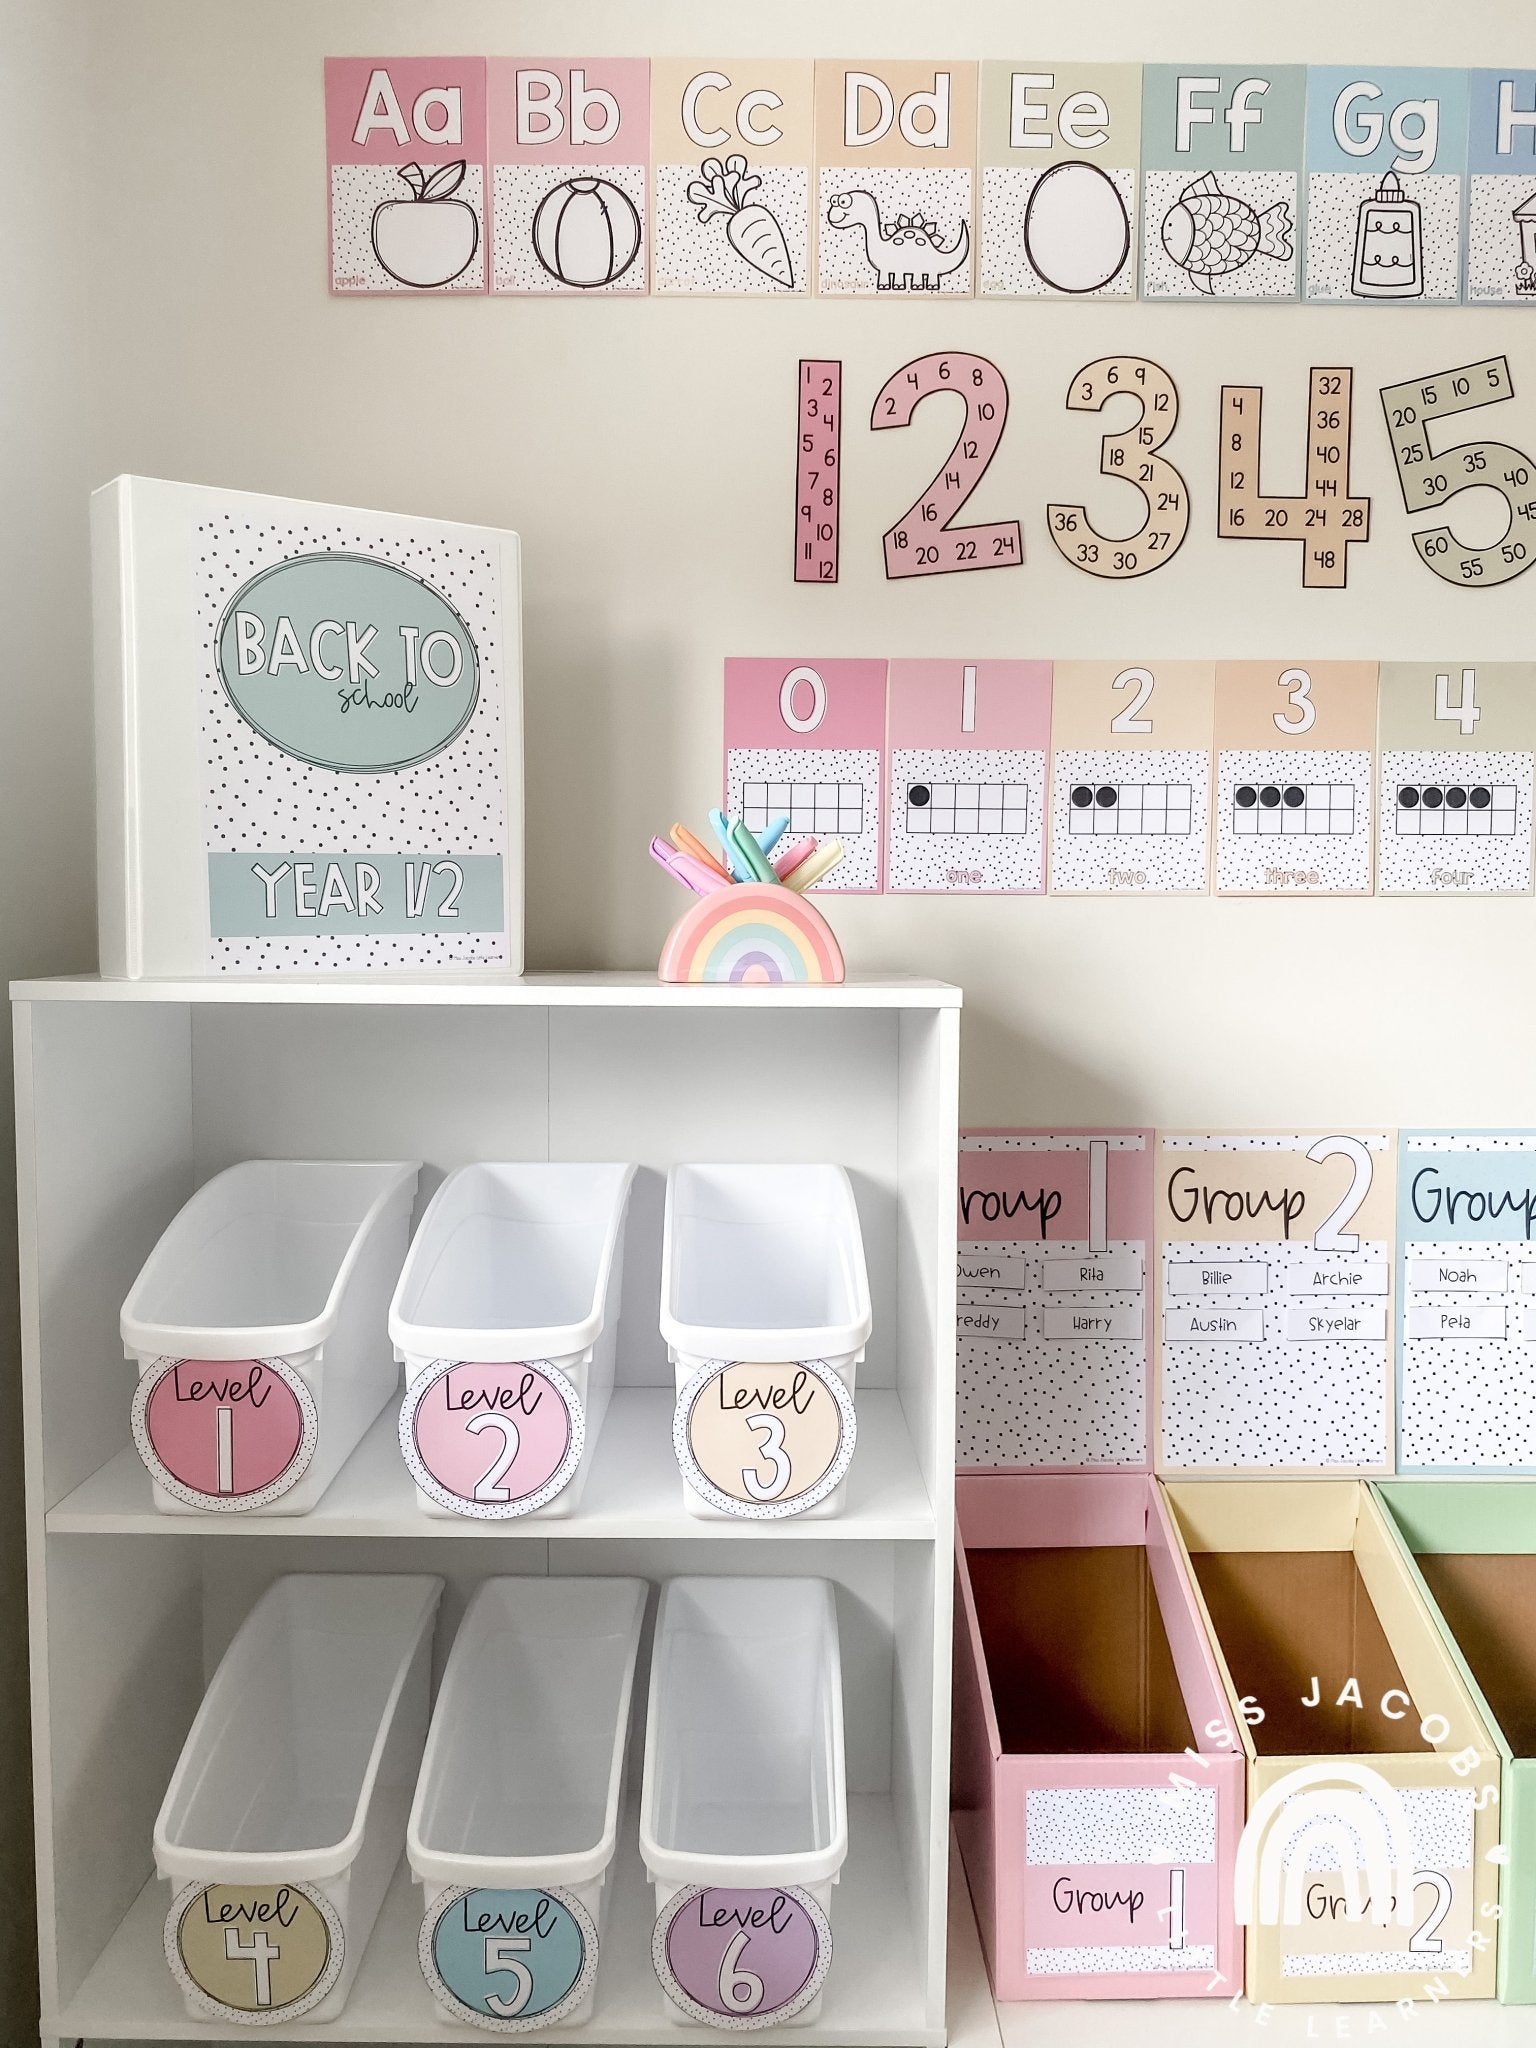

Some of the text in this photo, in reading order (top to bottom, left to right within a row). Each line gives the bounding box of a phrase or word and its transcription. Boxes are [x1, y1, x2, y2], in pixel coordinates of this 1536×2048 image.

[351, 69, 463, 147] Aa
[516, 69, 621, 146] Bb
[681, 71, 784, 147] Cc
[844, 71, 951, 148] Dd
[1009, 72, 1110, 150] Ee
[1175, 76, 1271, 153] Ff
[1333, 80, 1441, 175] Gg
[334, 275, 366, 287] apple
[820, 278, 870, 289] dinosaur
[1147, 281, 1168, 292] fish
[1307, 284, 1332, 295] glue
[1469, 285, 1503, 295] house
[808, 367, 810, 384] 1
[939, 362, 950, 379] 6
[973, 369, 983, 386] 8
[1108, 366, 1118, 383] 6
[1135, 368, 1145, 385] 9
[823, 379, 832, 395] 2
[907, 373, 918, 389] 4
[1319, 377, 1341, 395] 32
[1421, 369, 1499, 405] 15 10 5
[1082, 383, 1092, 400] 3
[808, 399, 818, 417] 3
[886, 398, 896, 415] 2
[1155, 394, 1168, 411] 12
[1233, 398, 1242, 415] 4
[978, 403, 994, 421] 10
[1318, 411, 1339, 429] 36
[1393, 407, 1416, 427] 20
[824, 415, 833, 432] 4
[803, 434, 813, 452] 5
[1139, 428, 1153, 445] 15
[1232, 434, 1241, 451] 8
[825, 449, 835, 466] 6
[964, 441, 978, 459] 12
[1110, 449, 1124, 466] 18
[1317, 446, 1340, 463] 40
[1401, 444, 1423, 465] 25
[794, 351, 1536, 588] 1 2 3 4 5
[1463, 451, 1486, 472] 35
[808, 472, 819, 489] 7
[946, 472, 960, 489] 14
[1139, 464, 1153, 481] 21
[1231, 472, 1244, 489] 12
[1504, 468, 1528, 487] 40
[1316, 480, 1336, 497] 44
[1423, 475, 1447, 495] 30
[823, 488, 833, 506] 8
[1158, 493, 1178, 510] 24
[801, 506, 811, 522] 9
[922, 504, 937, 521] 16
[1230, 509, 1363, 527] 16 20 24 28
[1518, 501, 1536, 520] 45
[1055, 513, 1077, 531] 36
[817, 524, 833, 541] 10
[894, 531, 908, 549] 18
[1148, 533, 1170, 549] 27
[805, 543, 811, 559] 11
[916, 537, 1014, 564] 20 22 24
[1077, 544, 1098, 562] 33
[1425, 537, 1448, 557] 60
[1502, 543, 1526, 563] 50
[1113, 552, 1137, 569] 30
[1315, 551, 1334, 568] 48
[1461, 558, 1483, 578] 55
[818, 561, 834, 580] 12
[235, 611, 462, 687] BACK TO
[337, 678, 419, 714] school
[779, 665, 827, 734] 0
[961, 665, 977, 733] 1
[1110, 667, 1155, 734] 2
[1272, 668, 1317, 735] 3
[1434, 668, 1481, 735] 4
[946, 870, 982, 883] one
[1107, 868, 1147, 885] two
[1264, 868, 1319, 885] three
[1431, 868, 1475, 886] four
[250, 860, 384, 918] YEAR
[958, 1140, 1108, 1252] roup 1
[1167, 1135, 1374, 1252] Group 2
[1080, 1267, 1104, 1282] Rita
[1202, 1270, 1232, 1287] Billie
[1312, 1270, 1363, 1287] Archie
[1439, 1267, 1477, 1283] Noah
[957, 1314, 1000, 1331] reddy
[1073, 1316, 1112, 1331] Harry
[1189, 1316, 1237, 1332] Austin
[1308, 1316, 1361, 1334] Skyelar
[1441, 1314, 1471, 1329] Peta
[174, 1366, 272, 1408] Level
[445, 1372, 543, 1416] Level
[719, 1371, 816, 1415] Level
[217, 1407, 234, 1494] 1
[464, 1411, 520, 1501] 2
[741, 1412, 792, 1502] 3
[204, 1888, 299, 1928] Level
[698, 1894, 793, 1934] Level
[1052, 1869, 1184, 1949] Group 1
[1409, 1869, 1453, 1953] 2
[463, 1897, 558, 1939] Level
[224, 1927, 280, 2006] 4
[718, 1930, 765, 2014] 6
[483, 1936, 534, 2017] 5
